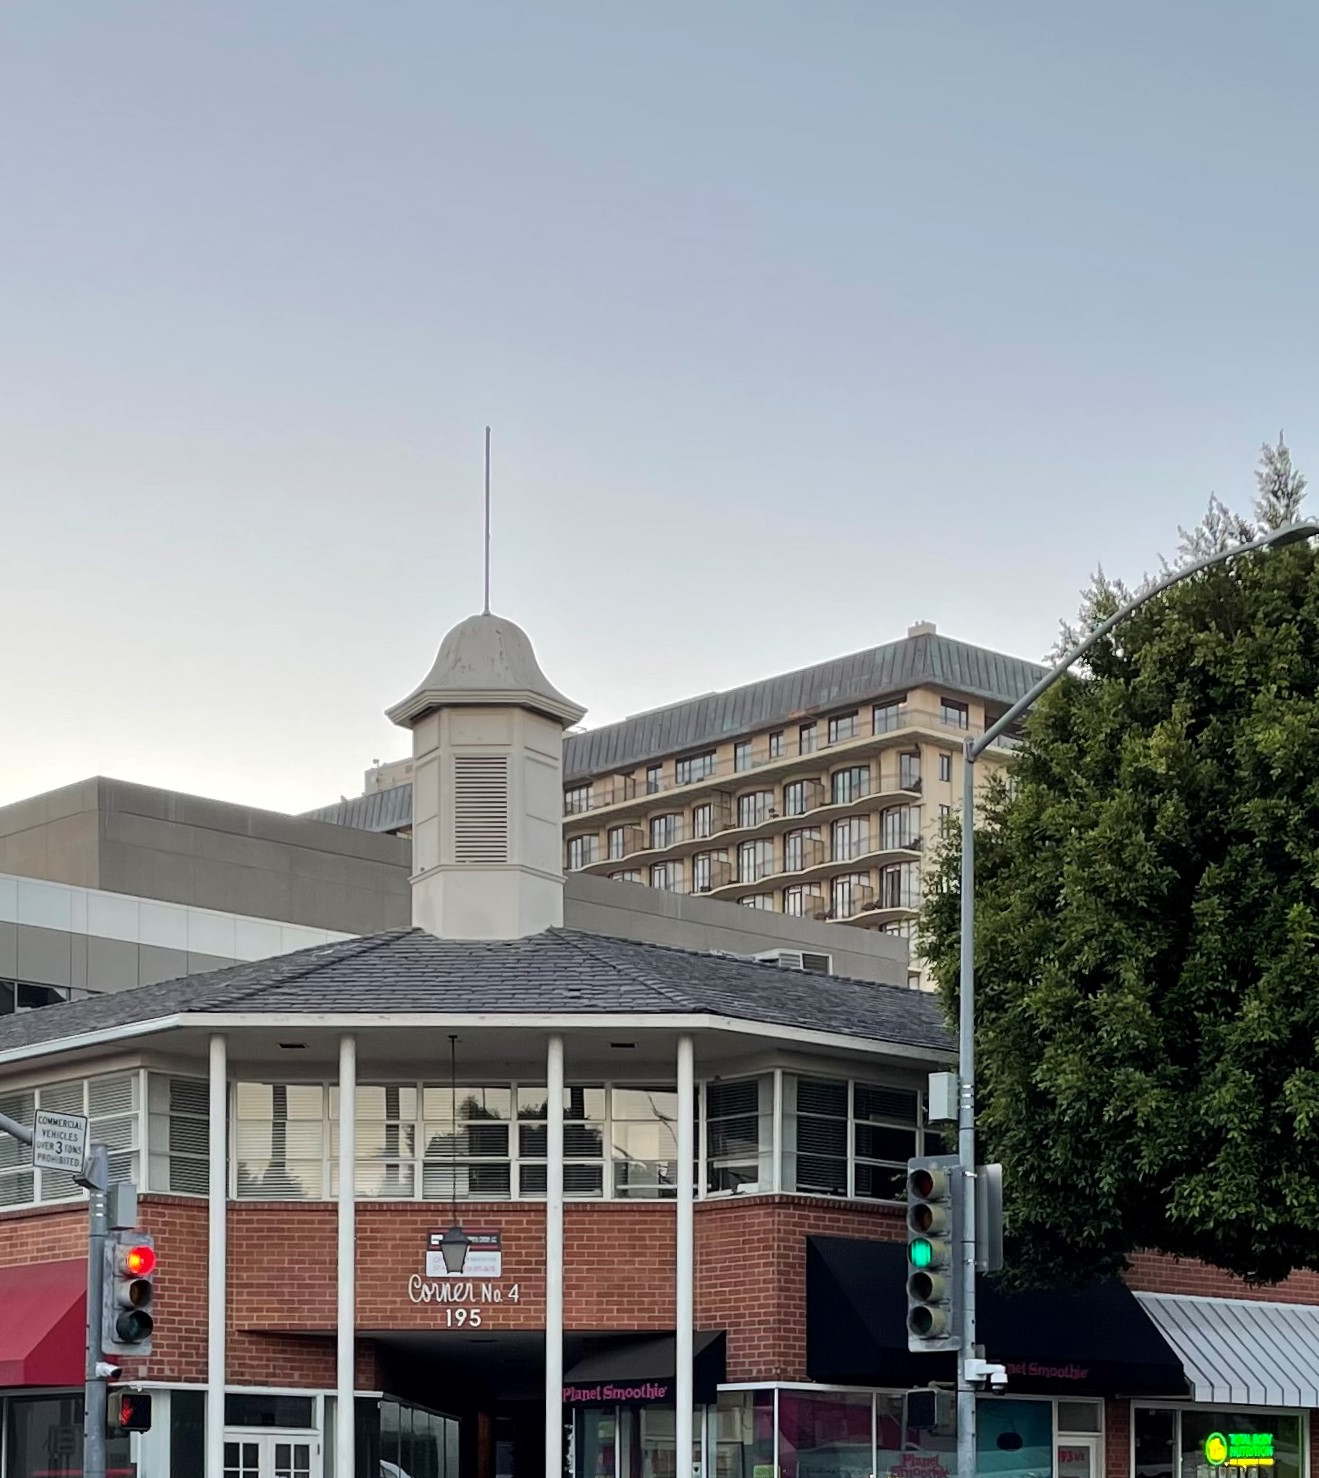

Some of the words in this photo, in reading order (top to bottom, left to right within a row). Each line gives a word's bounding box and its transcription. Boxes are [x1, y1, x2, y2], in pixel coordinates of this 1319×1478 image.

[38, 1116, 83, 1130] COMMERCIAL
[42, 1129, 78, 1142] VEHICLES
[37, 1141, 54, 1150] OVER
[55, 1141, 63, 1154] 3
[64, 1144, 81, 1155] TONS
[37, 1153, 80, 1167] PROHIBITED
[408, 1274, 477, 1303] Corner
[508, 1283, 519, 1303] 4
[446, 1308, 482, 1328] 195
[1006, 1363, 1027, 1376] net
[1028, 1361, 1088, 1380] Smoothie
[562, 1385, 602, 1403] Planet
[603, 1382, 667, 1400] Smoothie
[902, 1453, 940, 1467] Planet
